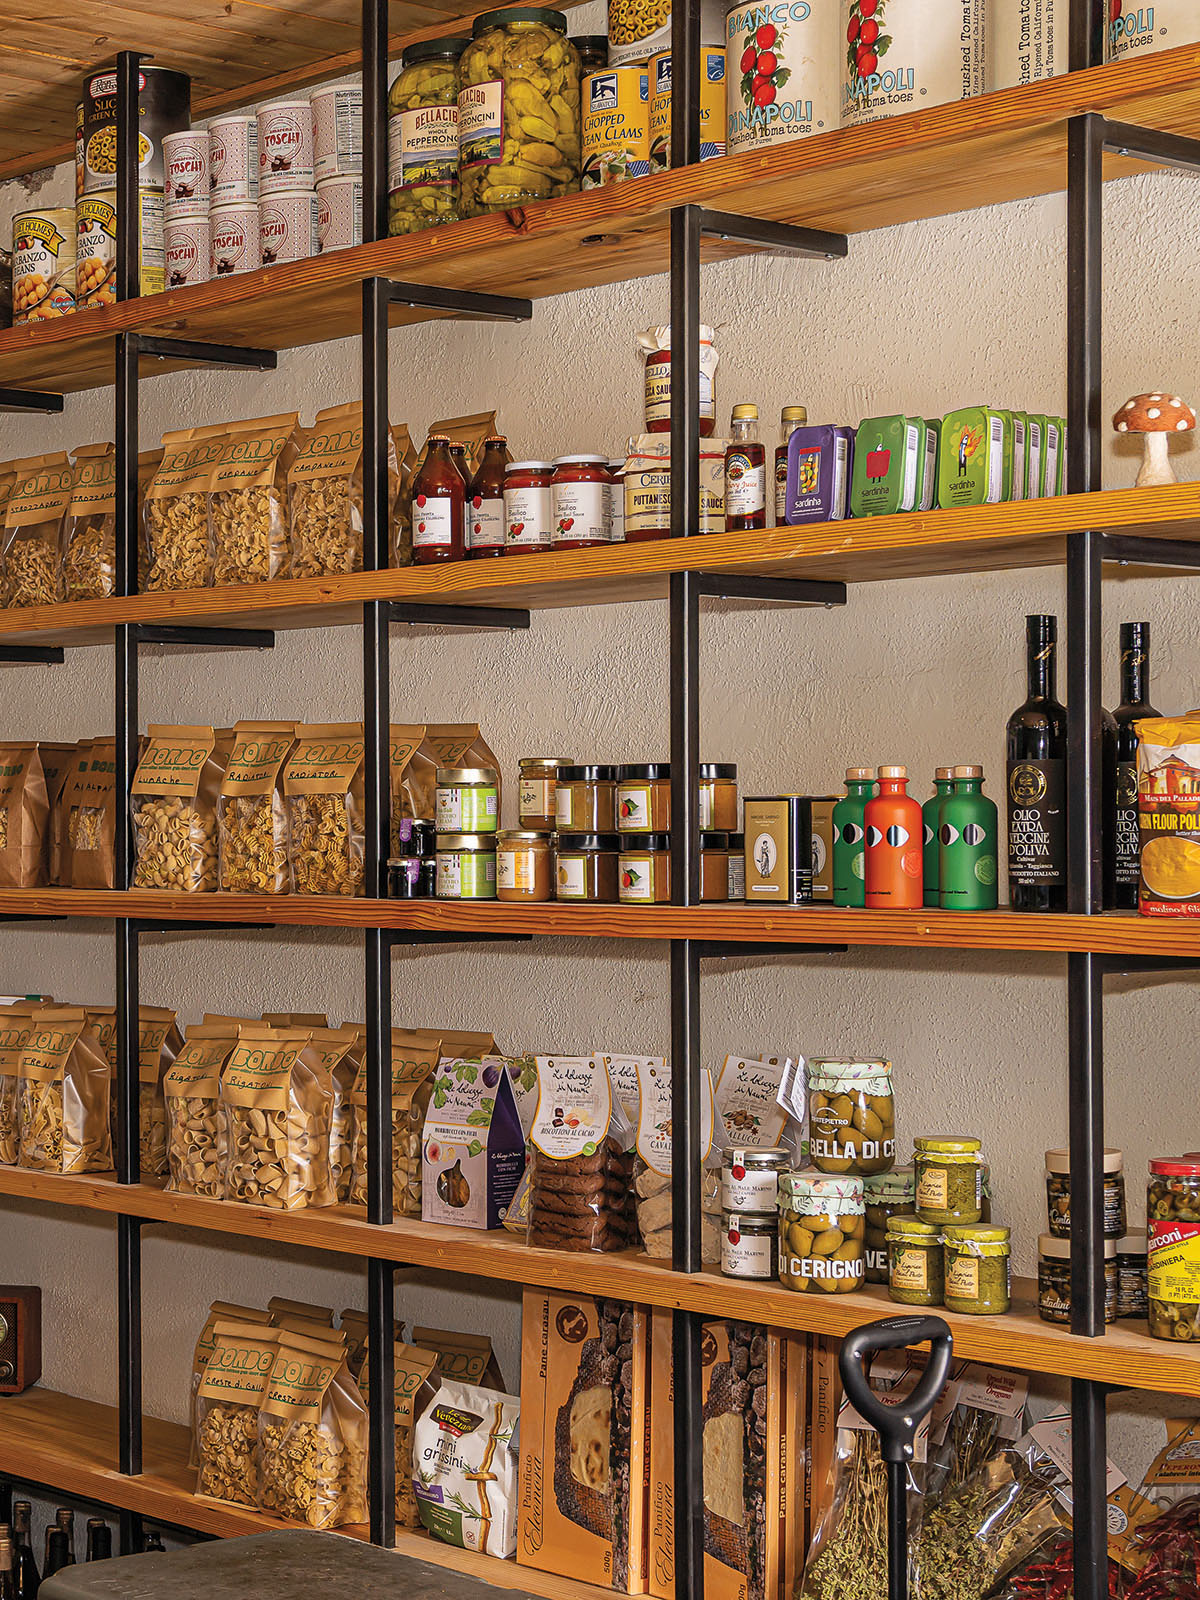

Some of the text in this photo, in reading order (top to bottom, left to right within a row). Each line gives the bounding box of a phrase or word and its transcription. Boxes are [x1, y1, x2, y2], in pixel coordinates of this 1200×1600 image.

[728, 1, 811, 38] BIANCO
[1019, 0, 1030, 51] Tomato
[1046, 24, 1054, 66] Tomatoes
[961, 46, 971, 100] rushed
[861, 91, 914, 109] Tomatoes
[415, 109, 458, 130] BELLACIB
[584, 114, 625, 131] CHOPPED
[604, 126, 643, 141] CLAMS
[758, 123, 812, 137] Tomatoes
[264, 131, 300, 147] TOSCHI
[406, 135, 458, 148] PEPPERONC
[169, 160, 202, 176] TOSCHI
[212, 234, 243, 249] TOSCHI
[166, 247, 195, 260] TOSCHI
[219, 437, 288, 461] BORDO
[741, 480, 759, 489] Juice
[861, 486, 890, 498] sardinha
[949, 480, 976, 491] sardinha
[633, 493, 724, 509] PUTTANESC SAUCE
[794, 497, 822, 508] sardinha
[141, 747, 208, 766] BORDO
[230, 740, 290, 762] BORDO
[291, 743, 364, 761] BORDO
[1013, 809, 1040, 821] OLIO
[1152, 813, 1178, 830] FLOUR
[1011, 821, 1044, 832] EXTRA
[1009, 832, 1050, 844] VERGINE
[1009, 844, 1050, 856] D'OLIVA
[1150, 904, 1182, 913] molino
[232, 1048, 297, 1070] BORDO
[810, 1138, 879, 1159] BELLA DI
[1049, 1209, 1071, 1224] Conta
[790, 1258, 864, 1279] CERIGNO
[1148, 1254, 1186, 1273] ARDINIERA
[539, 1300, 550, 1378] Pane carasau
[208, 1347, 275, 1371] BORDO
[272, 1358, 333, 1387] BORDO
[985, 1387, 1012, 1399] Oregano
[818, 1375, 829, 1434] Panificio
[436, 1438, 457, 1453] mini
[423, 1447, 464, 1469] grissini
[1159, 1463, 1200, 1471] PEPERON
[522, 1454, 532, 1509] Panificio
[524, 1457, 544, 1556] Eleonora
[654, 1481, 663, 1538] Panificio
[603, 1550, 613, 1573] 500g
